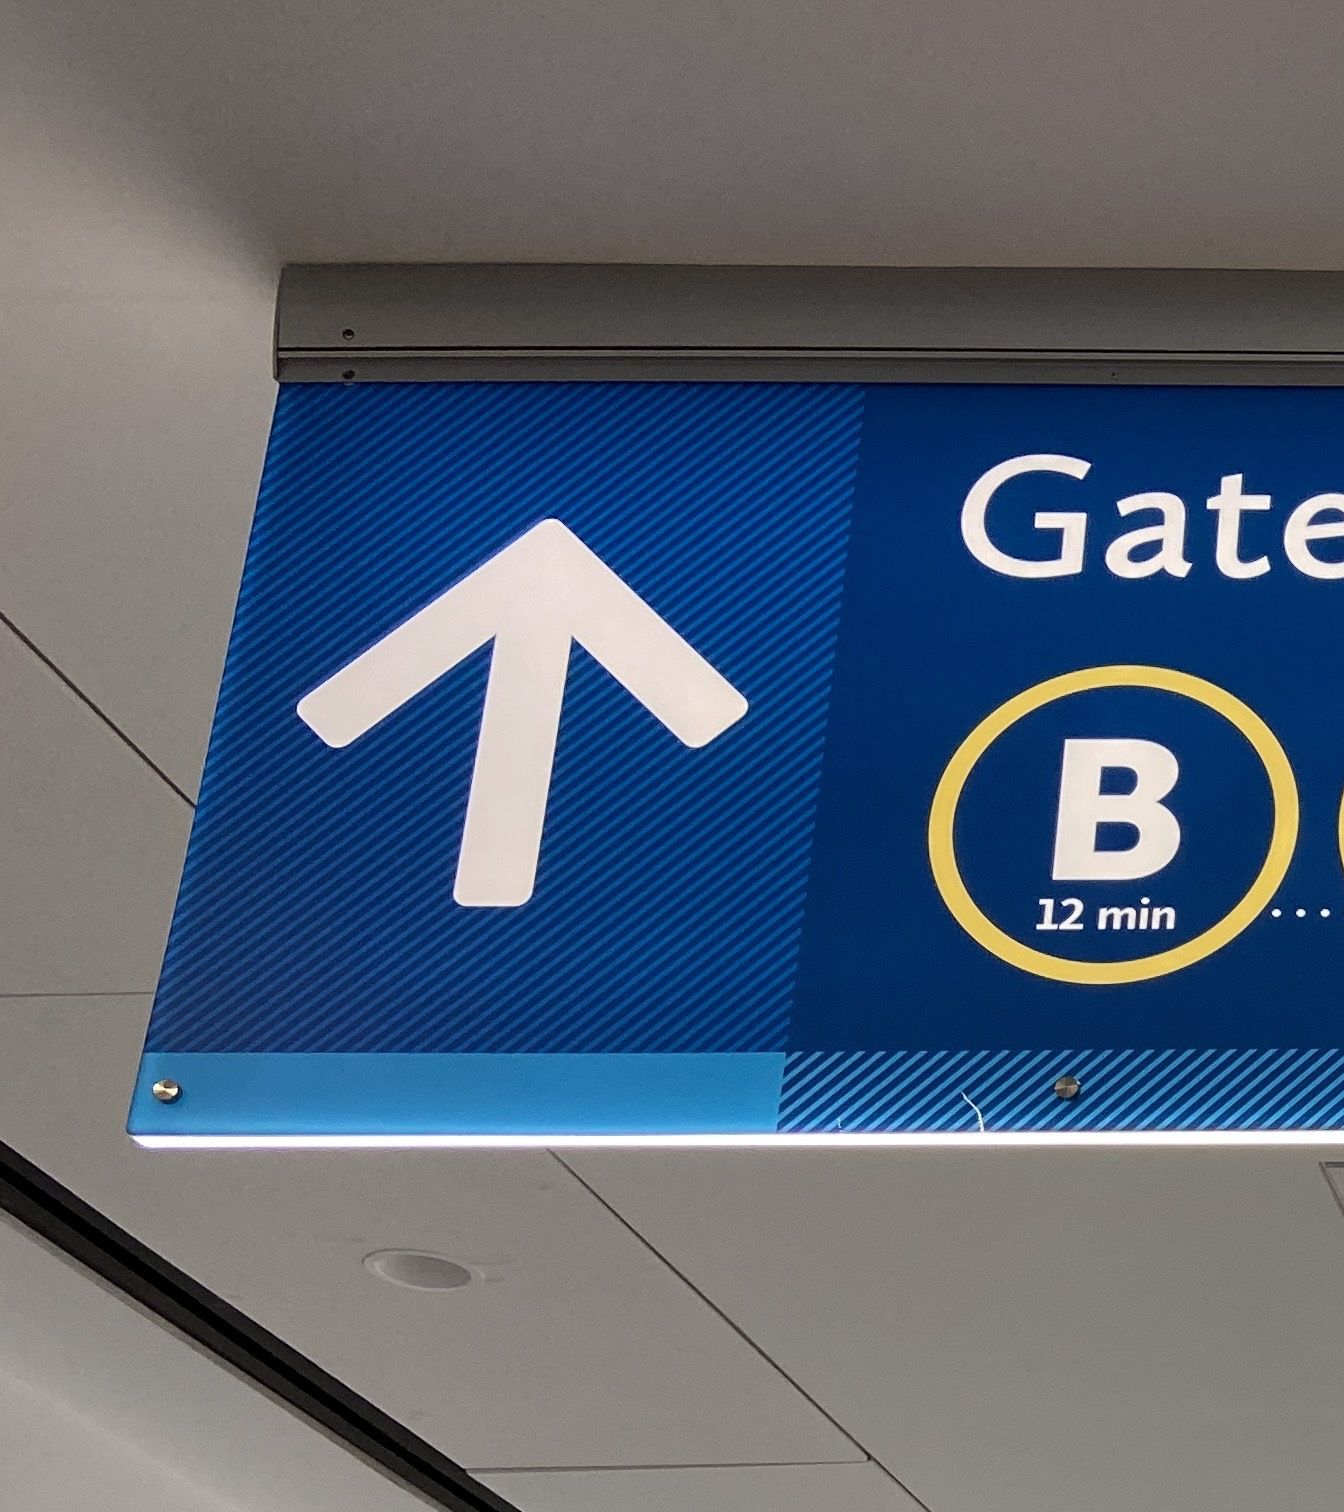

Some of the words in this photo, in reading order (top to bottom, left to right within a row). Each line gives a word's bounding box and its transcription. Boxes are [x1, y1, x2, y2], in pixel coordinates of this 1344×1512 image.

[1051, 738, 1182, 881] B
[1034, 897, 1084, 931] 12
[1096, 897, 1176, 931] min
